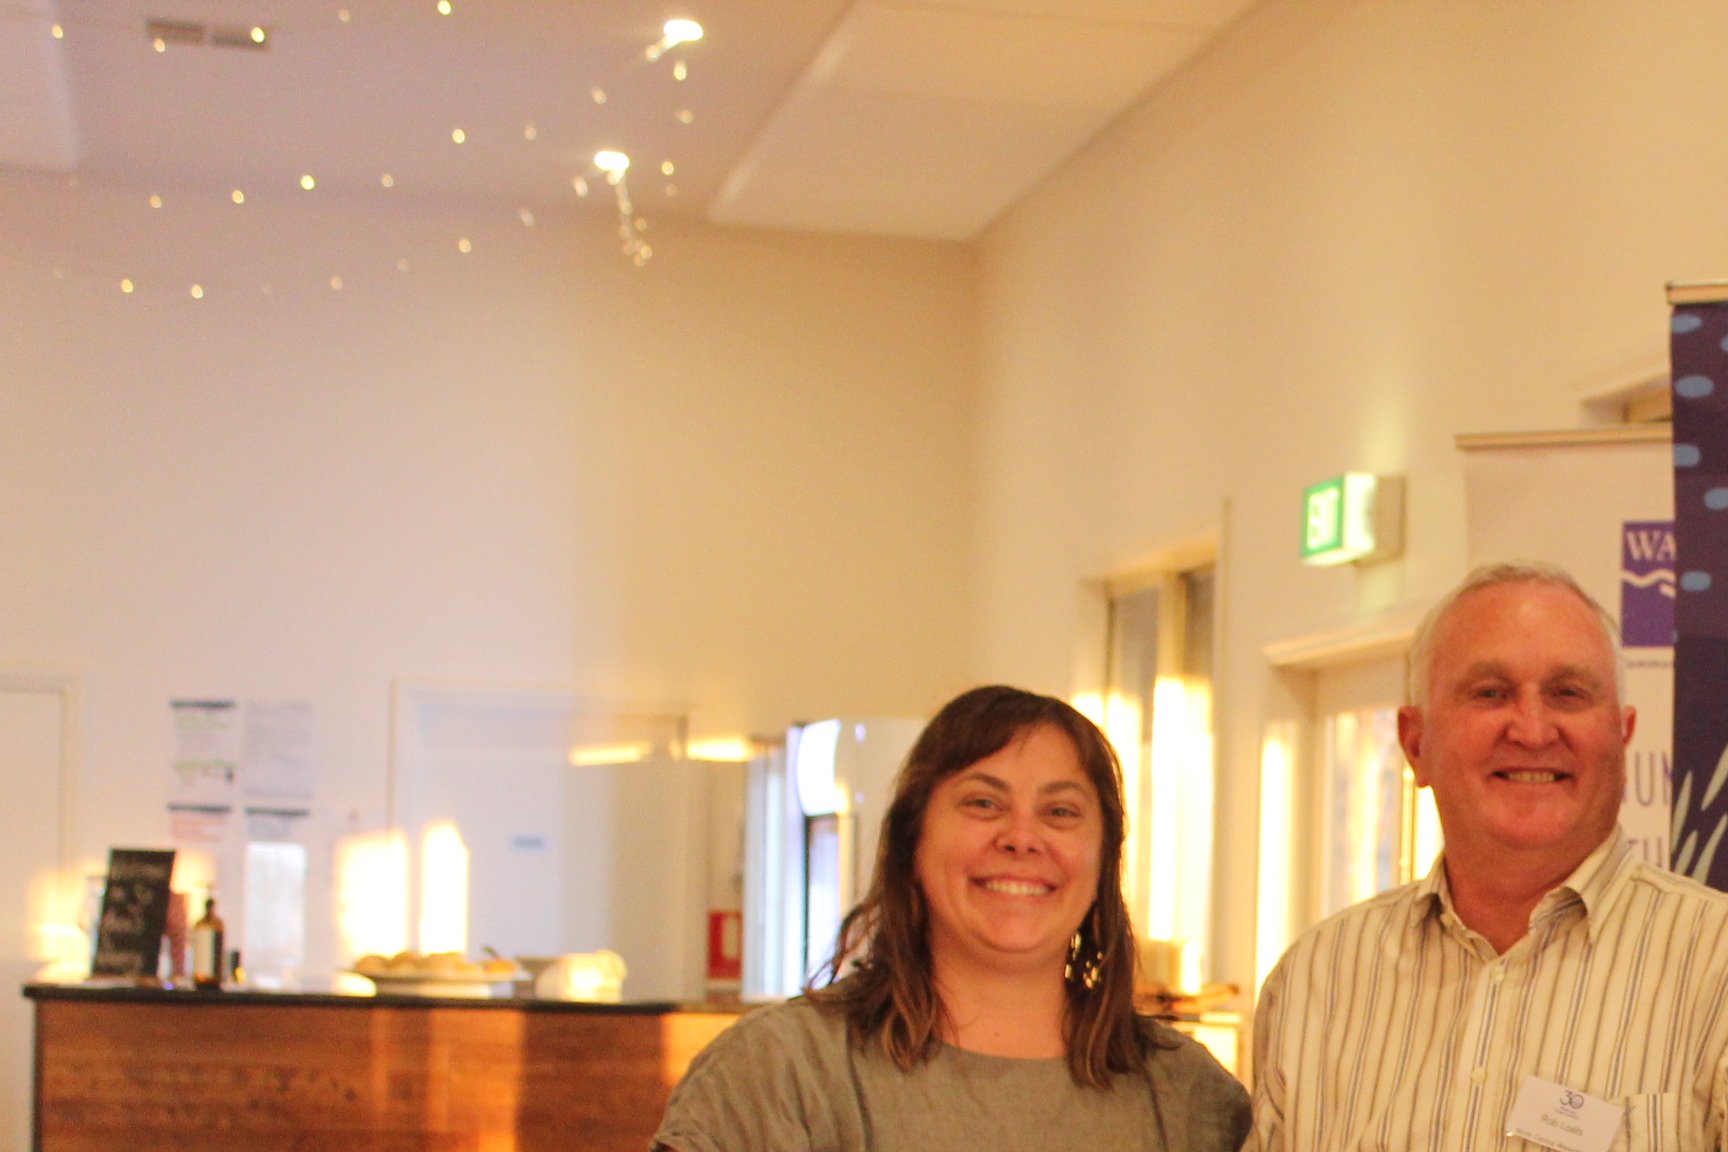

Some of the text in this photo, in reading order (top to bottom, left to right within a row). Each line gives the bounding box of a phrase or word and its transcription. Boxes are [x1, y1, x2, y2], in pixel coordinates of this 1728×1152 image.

[1626, 530, 1676, 561] WA
[1559, 1089, 1585, 1110] 30
[1541, 1113, 1559, 1128] Rob
